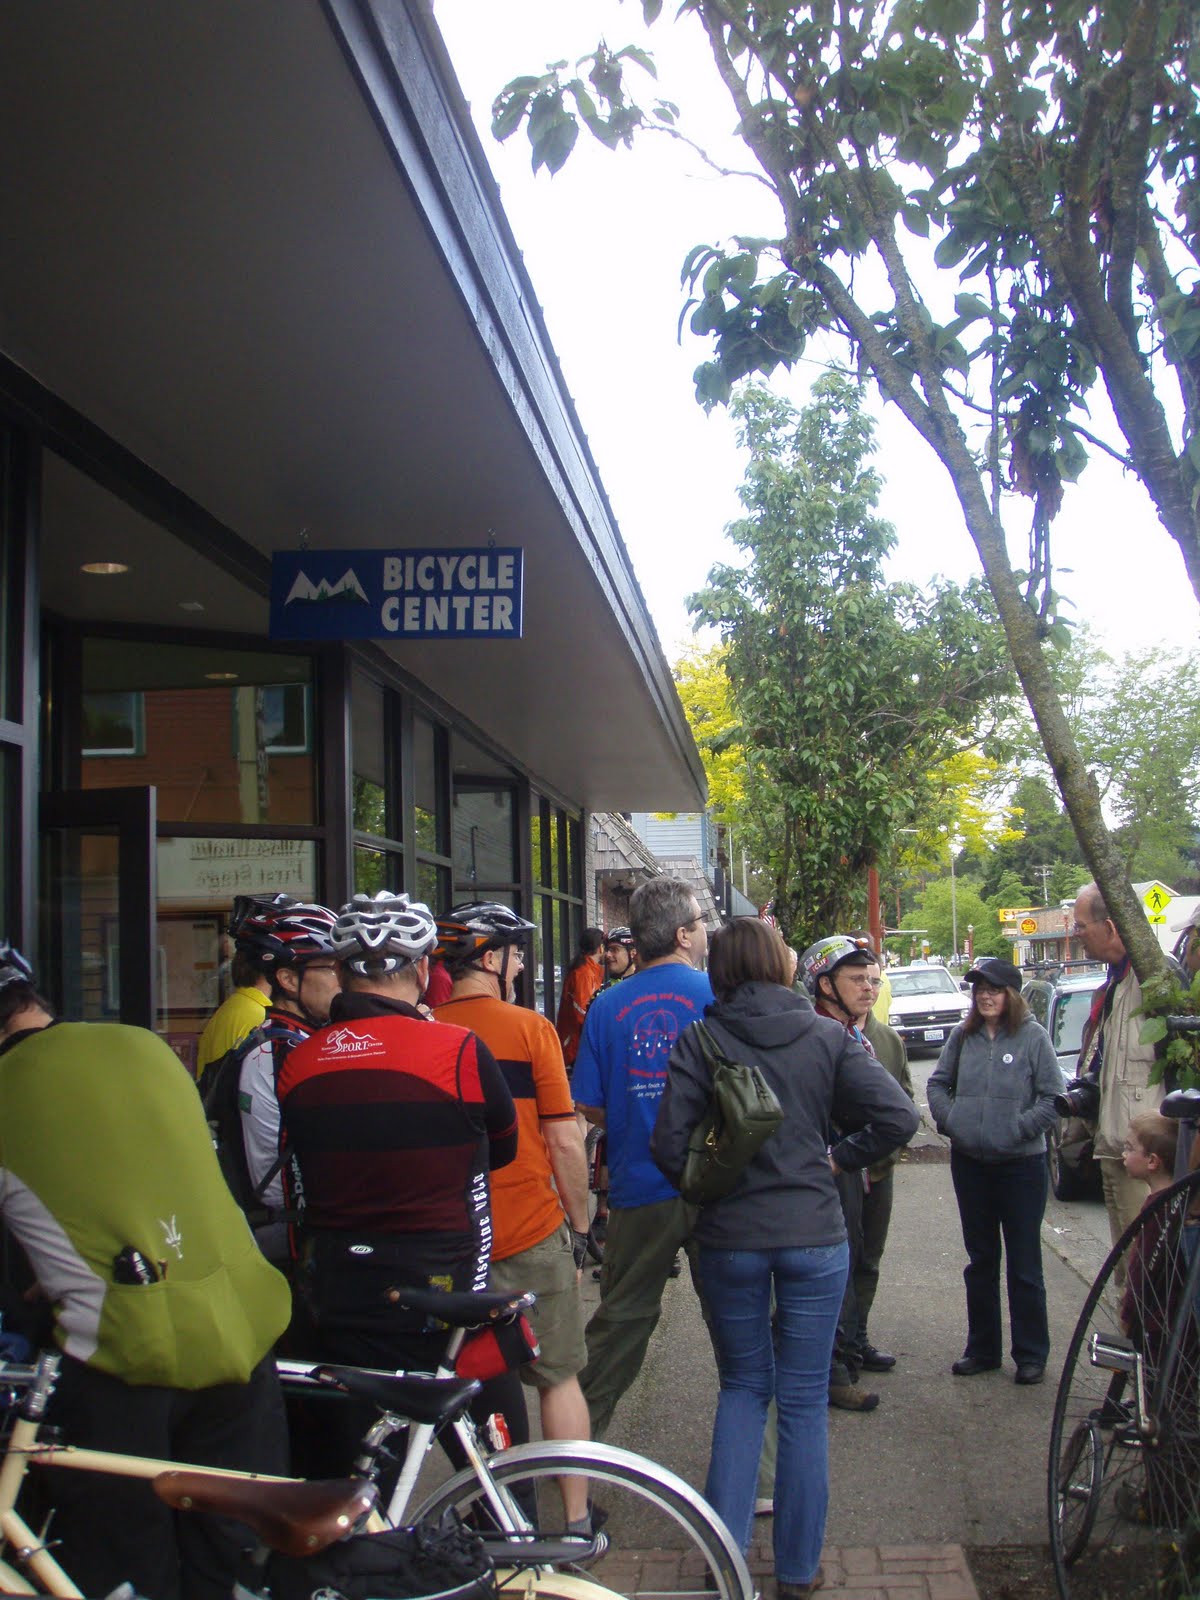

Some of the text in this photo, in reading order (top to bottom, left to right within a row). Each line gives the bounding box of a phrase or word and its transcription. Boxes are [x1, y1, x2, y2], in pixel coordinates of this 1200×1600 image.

[382, 555, 515, 591] BICYCLE
[380, 596, 514, 632] CENTER
[471, 1173, 488, 1212] VELO
